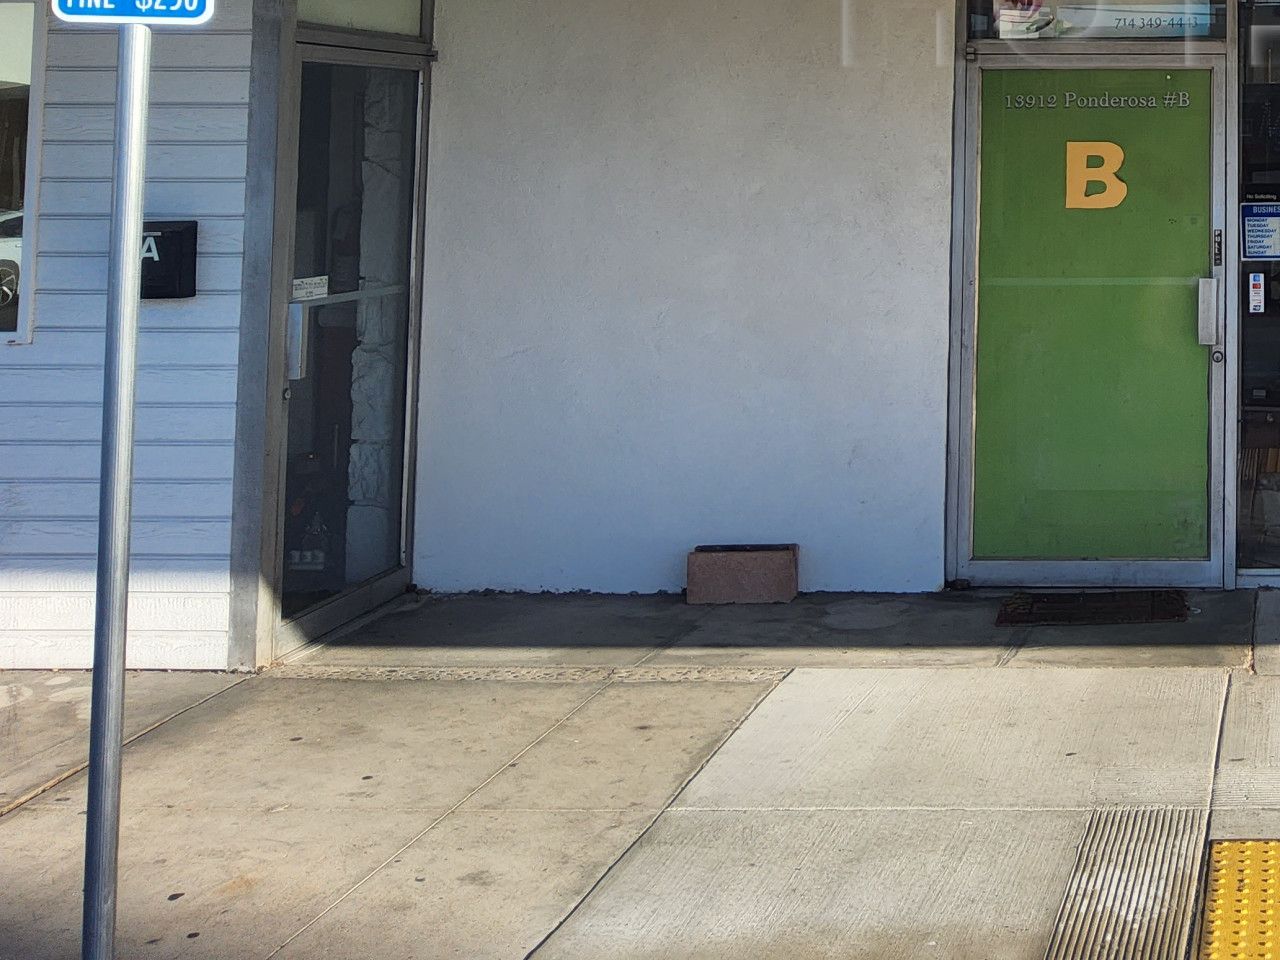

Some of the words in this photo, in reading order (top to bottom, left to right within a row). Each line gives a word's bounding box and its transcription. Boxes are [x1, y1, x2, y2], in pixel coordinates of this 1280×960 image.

[1115, 17, 1135, 30] 714
[1005, 94, 1057, 108] 13912
[1064, 91, 1158, 108] Ponderosa
[1164, 92, 1190, 108] #B
[1065, 140, 1128, 209] B
[140, 236, 160, 262] A
